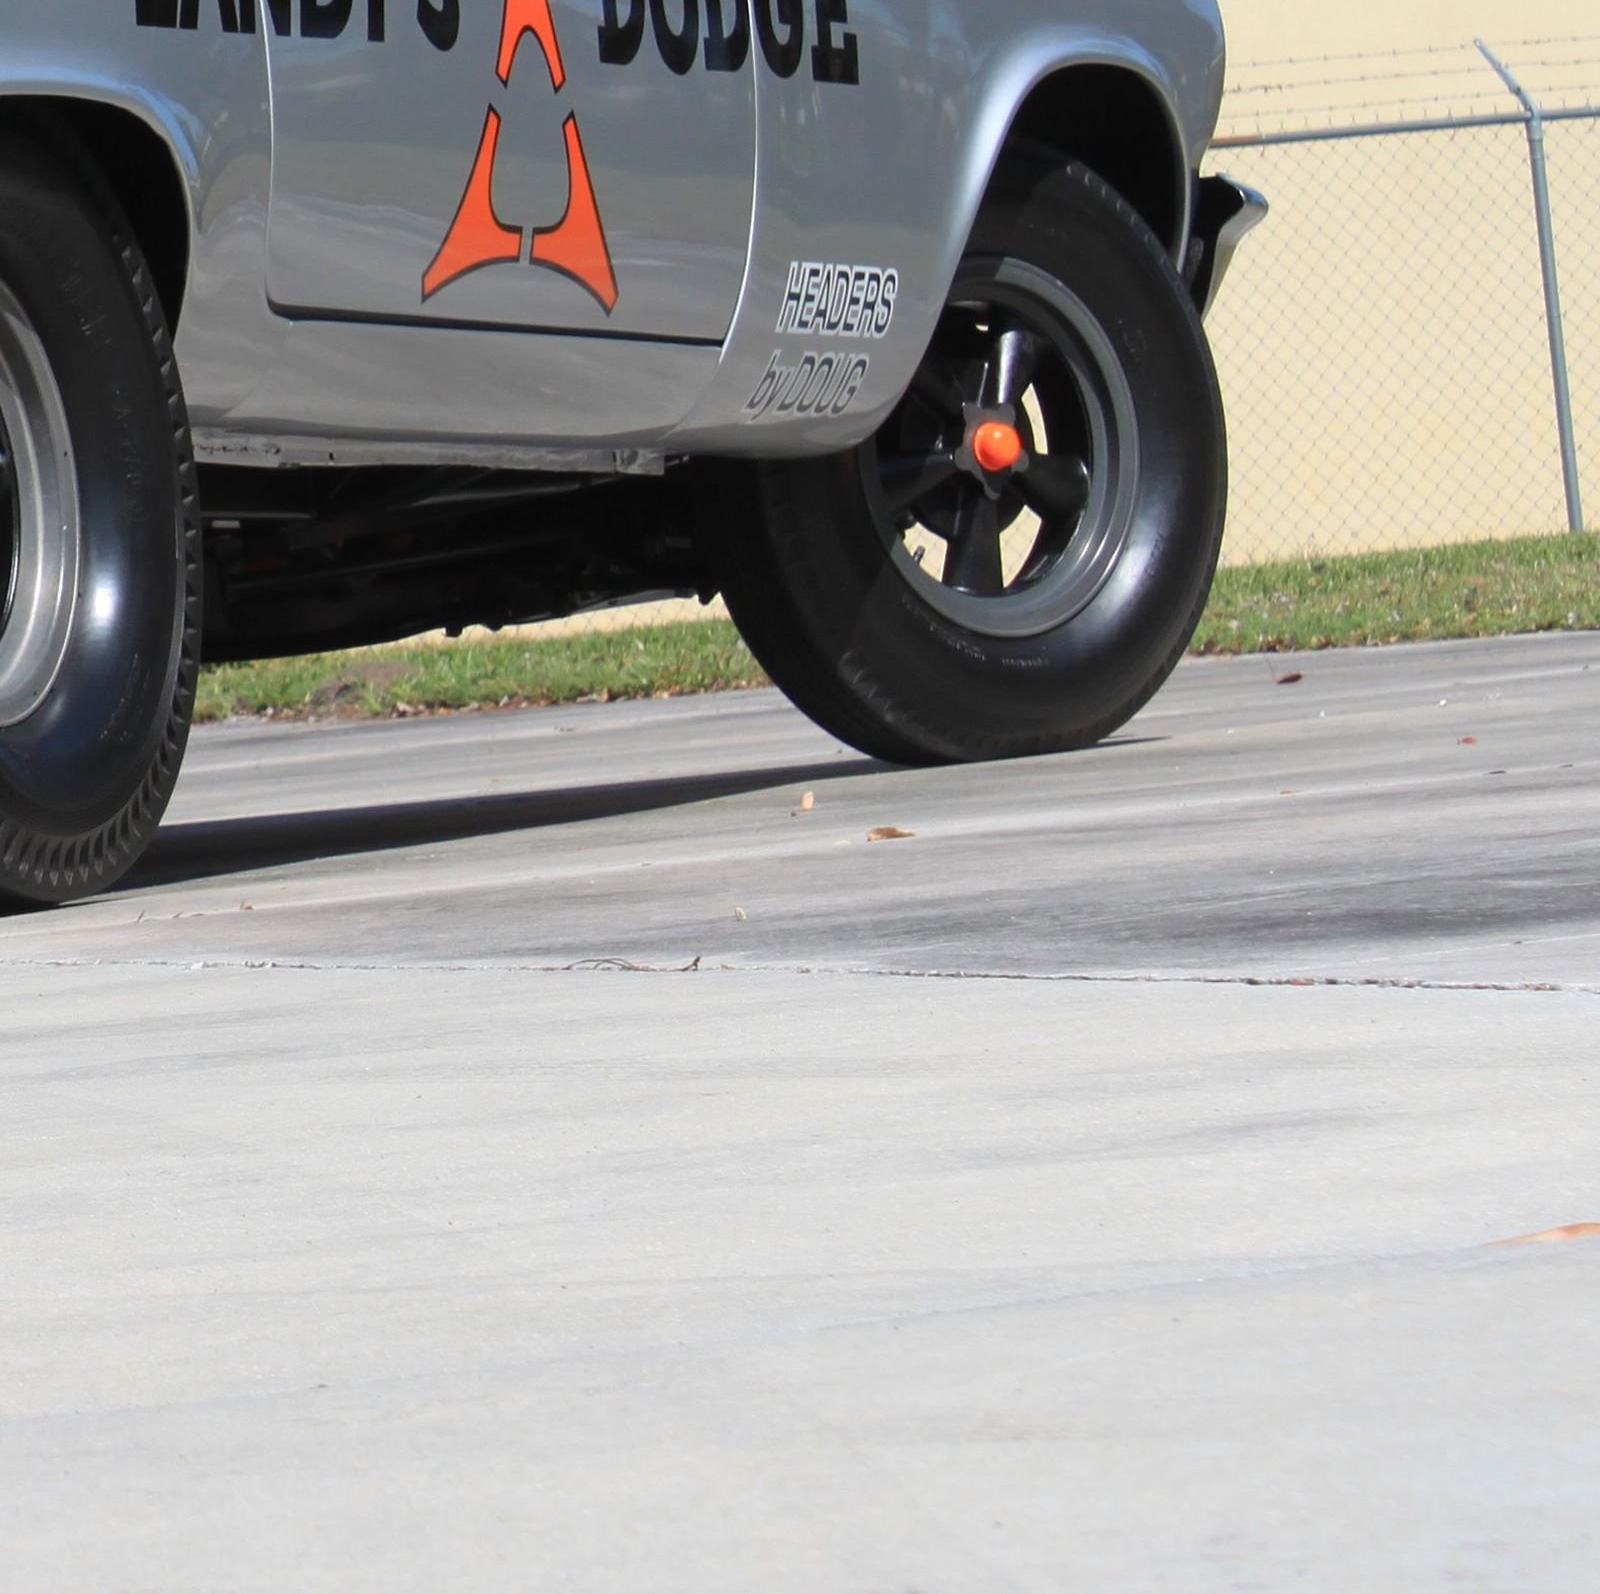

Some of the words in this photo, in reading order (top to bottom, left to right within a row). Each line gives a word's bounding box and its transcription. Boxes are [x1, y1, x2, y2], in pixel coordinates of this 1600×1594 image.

[775, 261, 898, 338] HEADERS
[741, 349, 795, 424] by
[776, 351, 869, 417] DOUG
